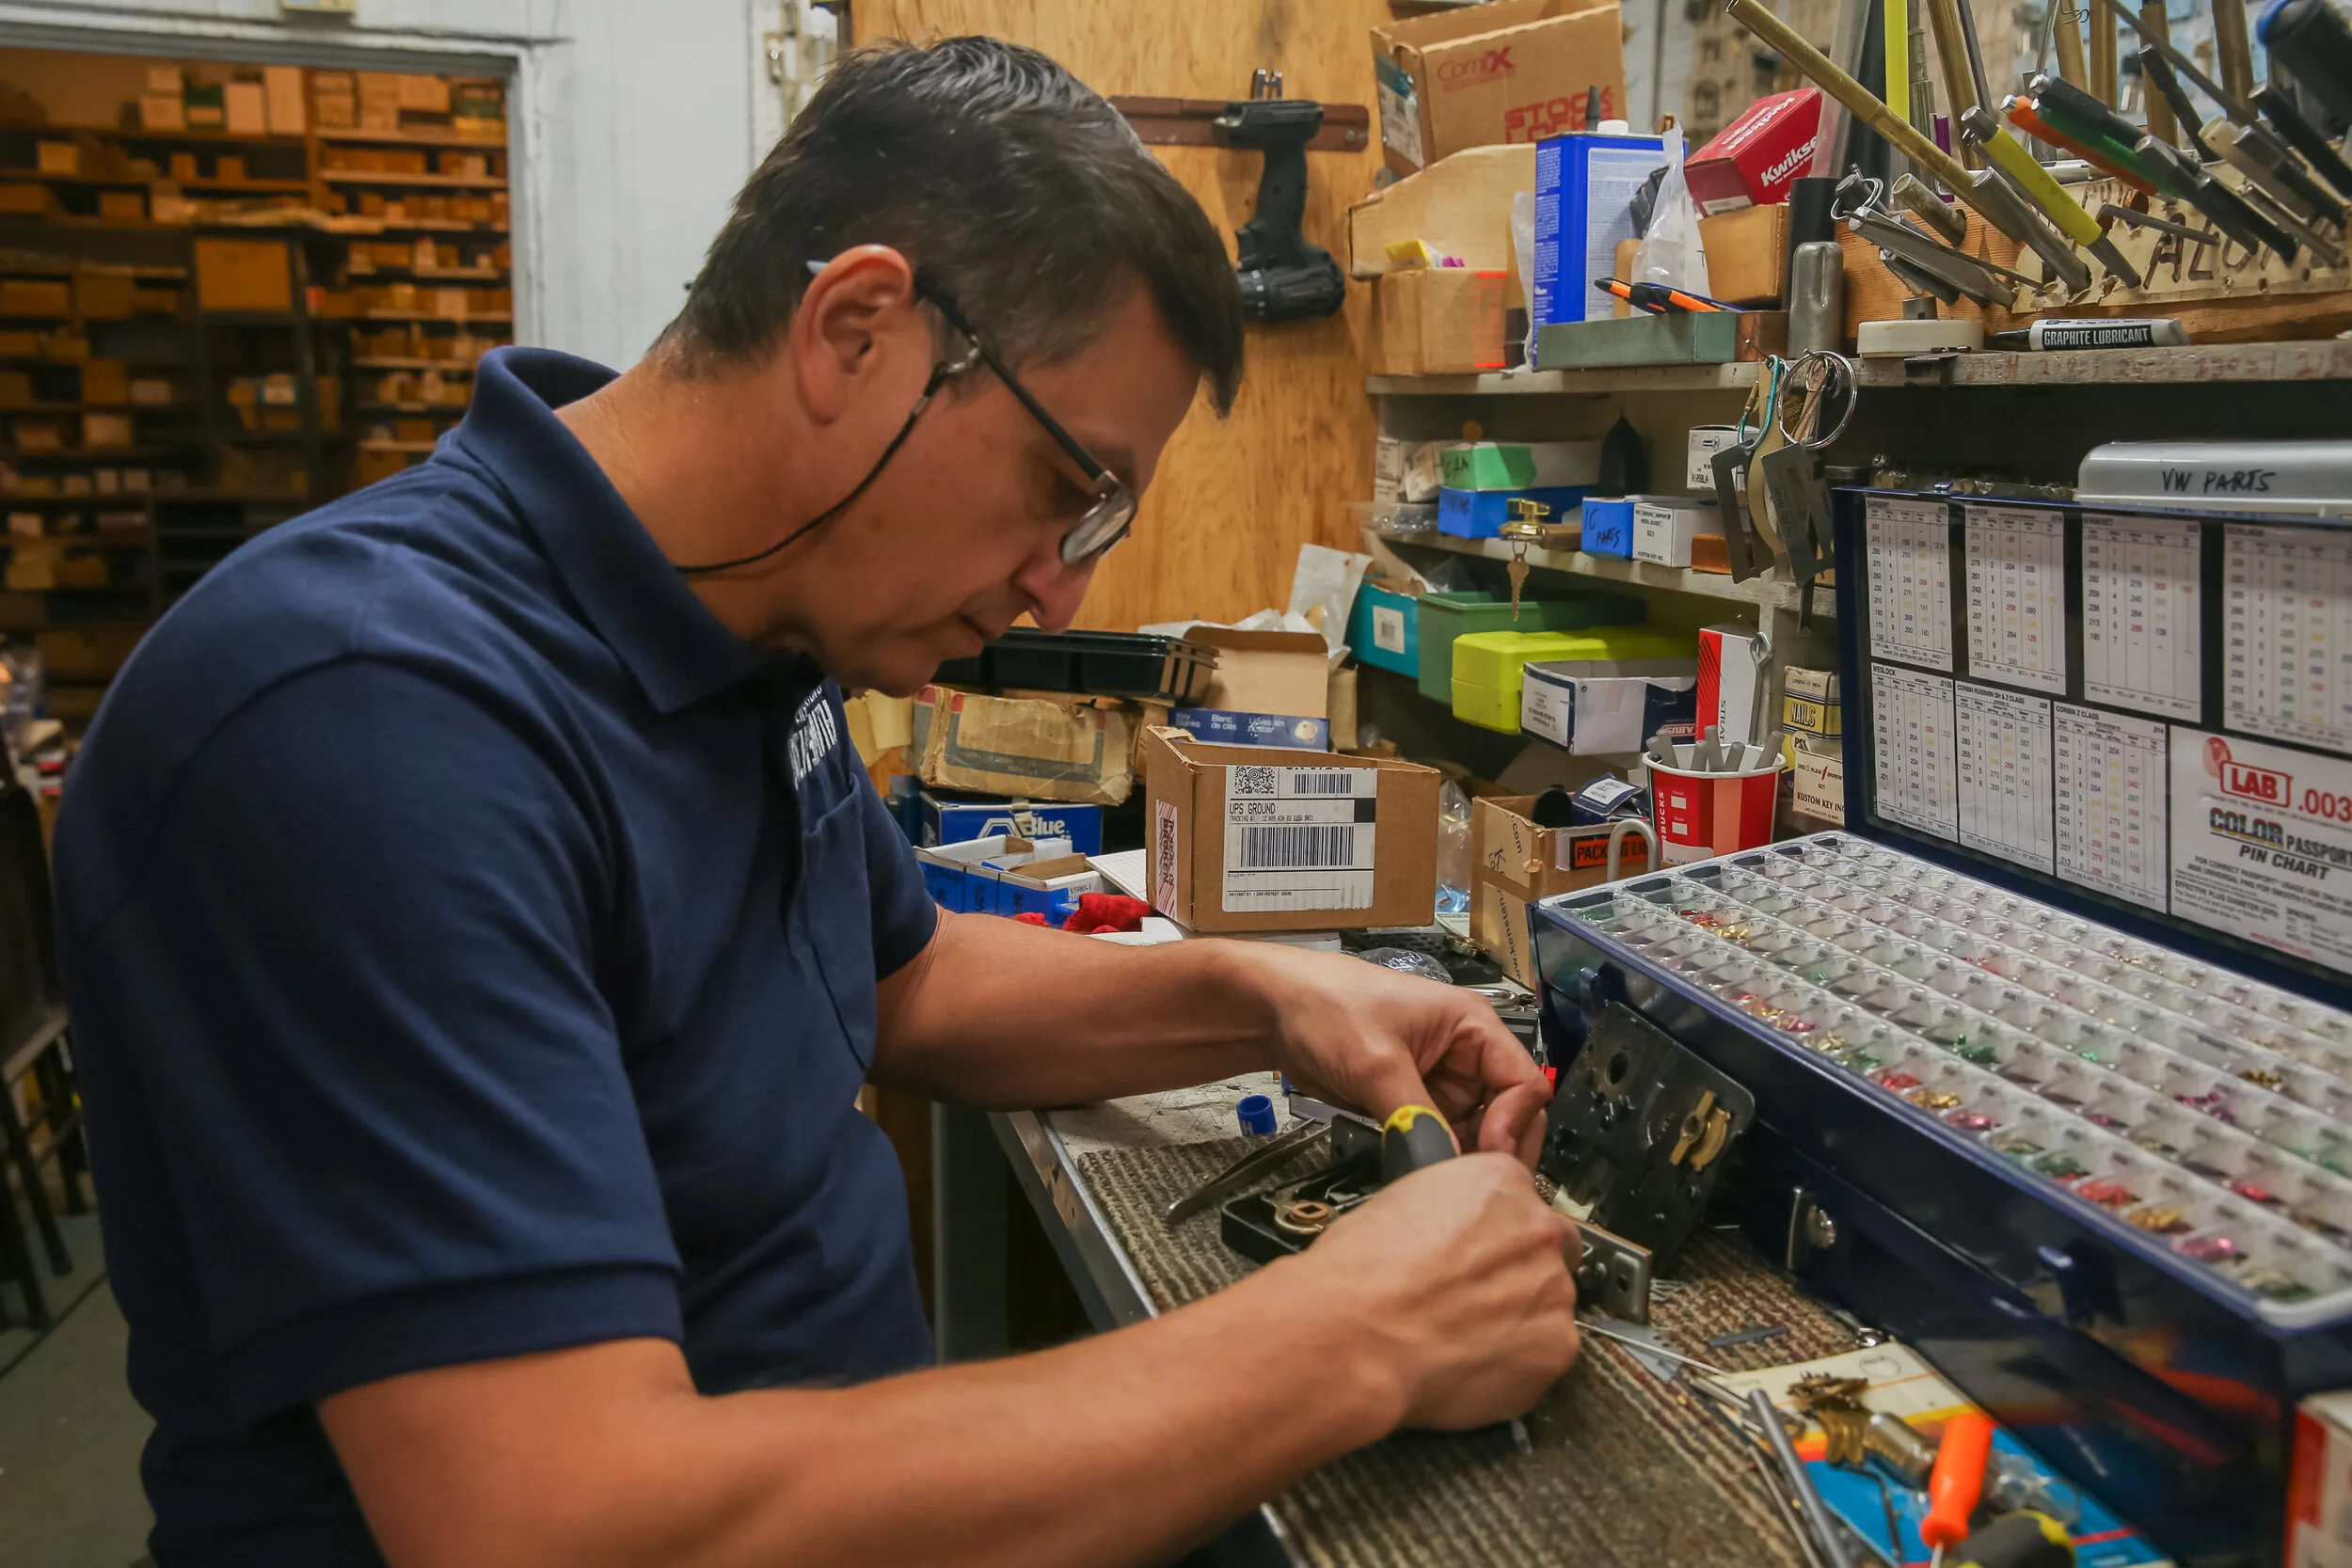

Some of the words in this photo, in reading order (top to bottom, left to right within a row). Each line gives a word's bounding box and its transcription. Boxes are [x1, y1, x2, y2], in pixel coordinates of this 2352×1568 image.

[1760, 135, 1818, 187] Kwikse
[2044, 330, 2090, 346] GRAPHITE
[2093, 327, 2148, 344] LUBRICANT
[2162, 468, 2193, 492] VW
[2203, 468, 2277, 494] PARTS
[1873, 667, 1896, 676] WESLOCK
[1211, 714, 1232, 723] Blanc
[1791, 701, 1816, 727] NAILS
[1827, 771, 1844, 781] IMPRIN
[1797, 792, 1820, 806] KUSTOM
[1822, 800, 1833, 809] KEY
[2231, 767, 2279, 800] LAB
[2298, 788, 2352, 823] .003
[1230, 802, 1244, 815] UPS
[1248, 802, 1275, 815] GROUND
[1659, 791, 1667, 841] RBUCKS
[2210, 807, 2285, 849] COLOR
[1576, 842, 1629, 862] PACKG
[2239, 845, 2268, 863] PIN
[2271, 852, 2331, 880] CHART
